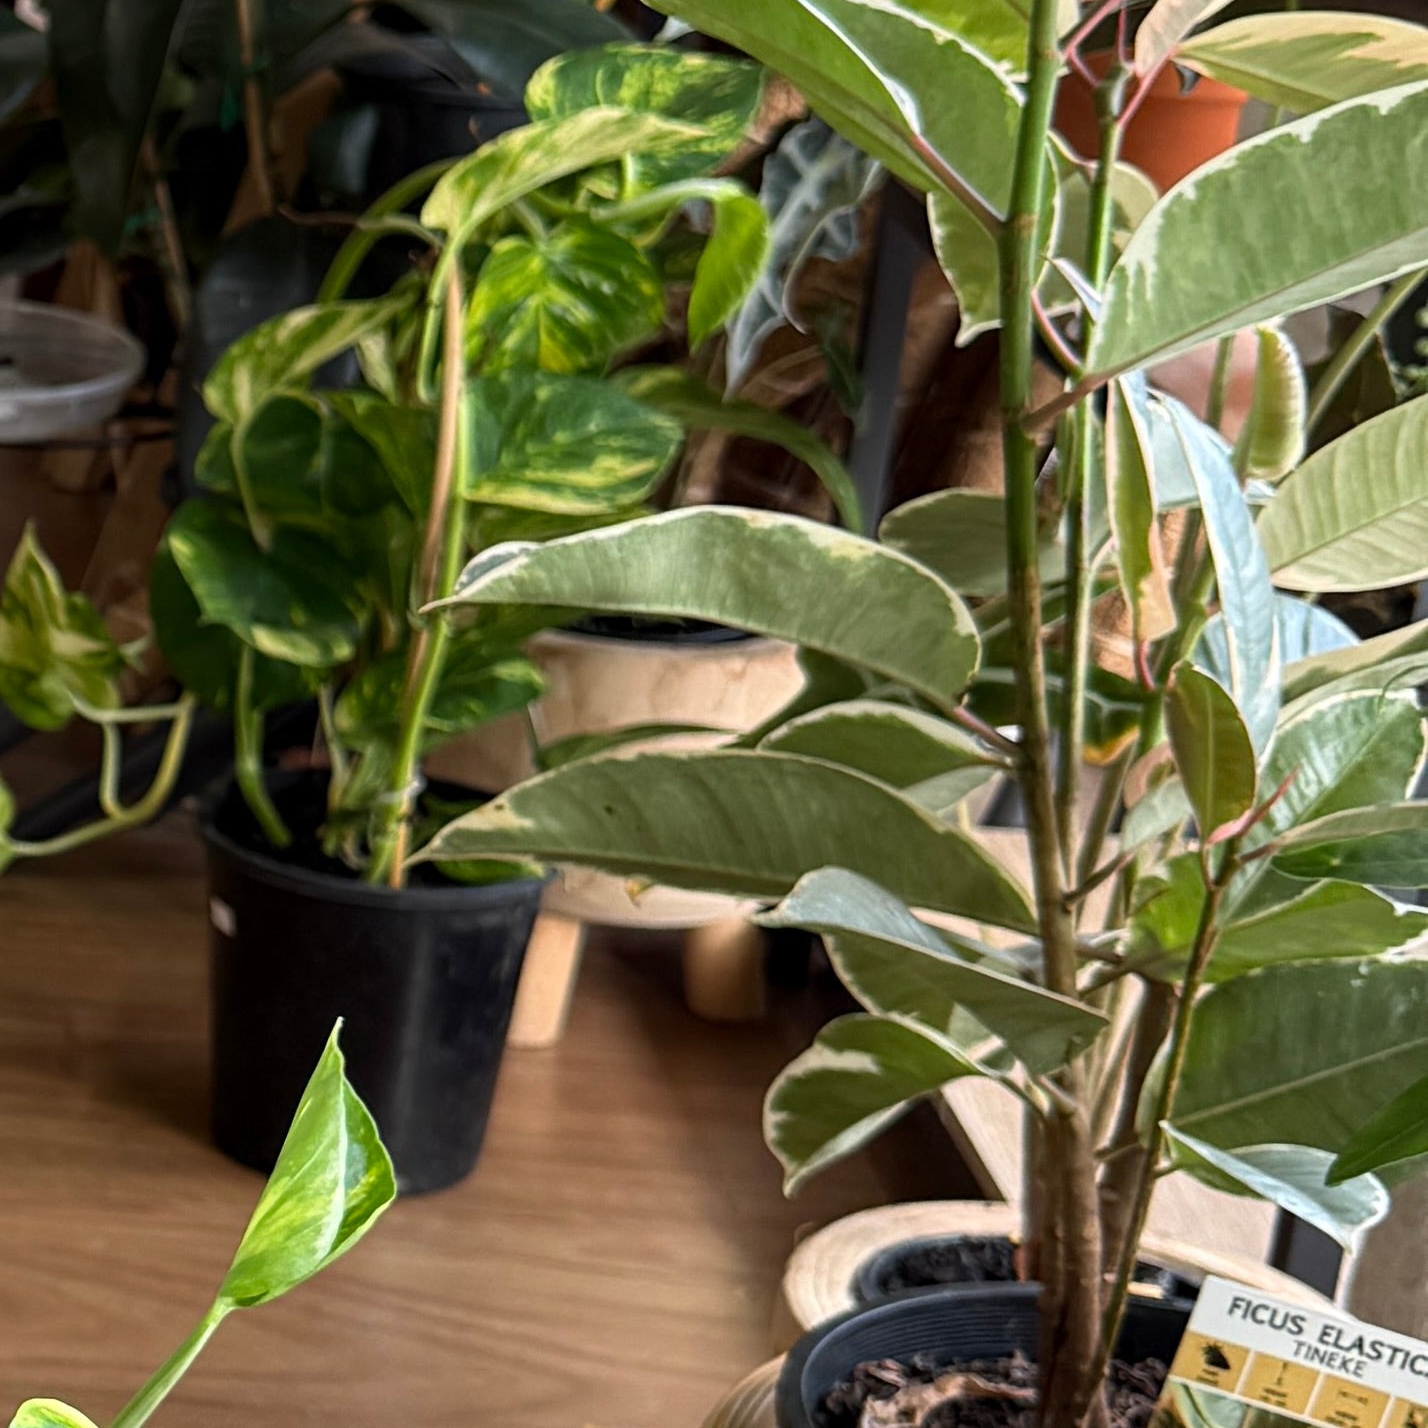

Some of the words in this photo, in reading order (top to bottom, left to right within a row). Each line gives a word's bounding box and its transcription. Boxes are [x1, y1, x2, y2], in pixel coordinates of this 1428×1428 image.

[1227, 1296, 1306, 1335] FICUS
[1318, 1324, 1428, 1377] ELASTIC
[1293, 1339, 1367, 1378] TINEKE
